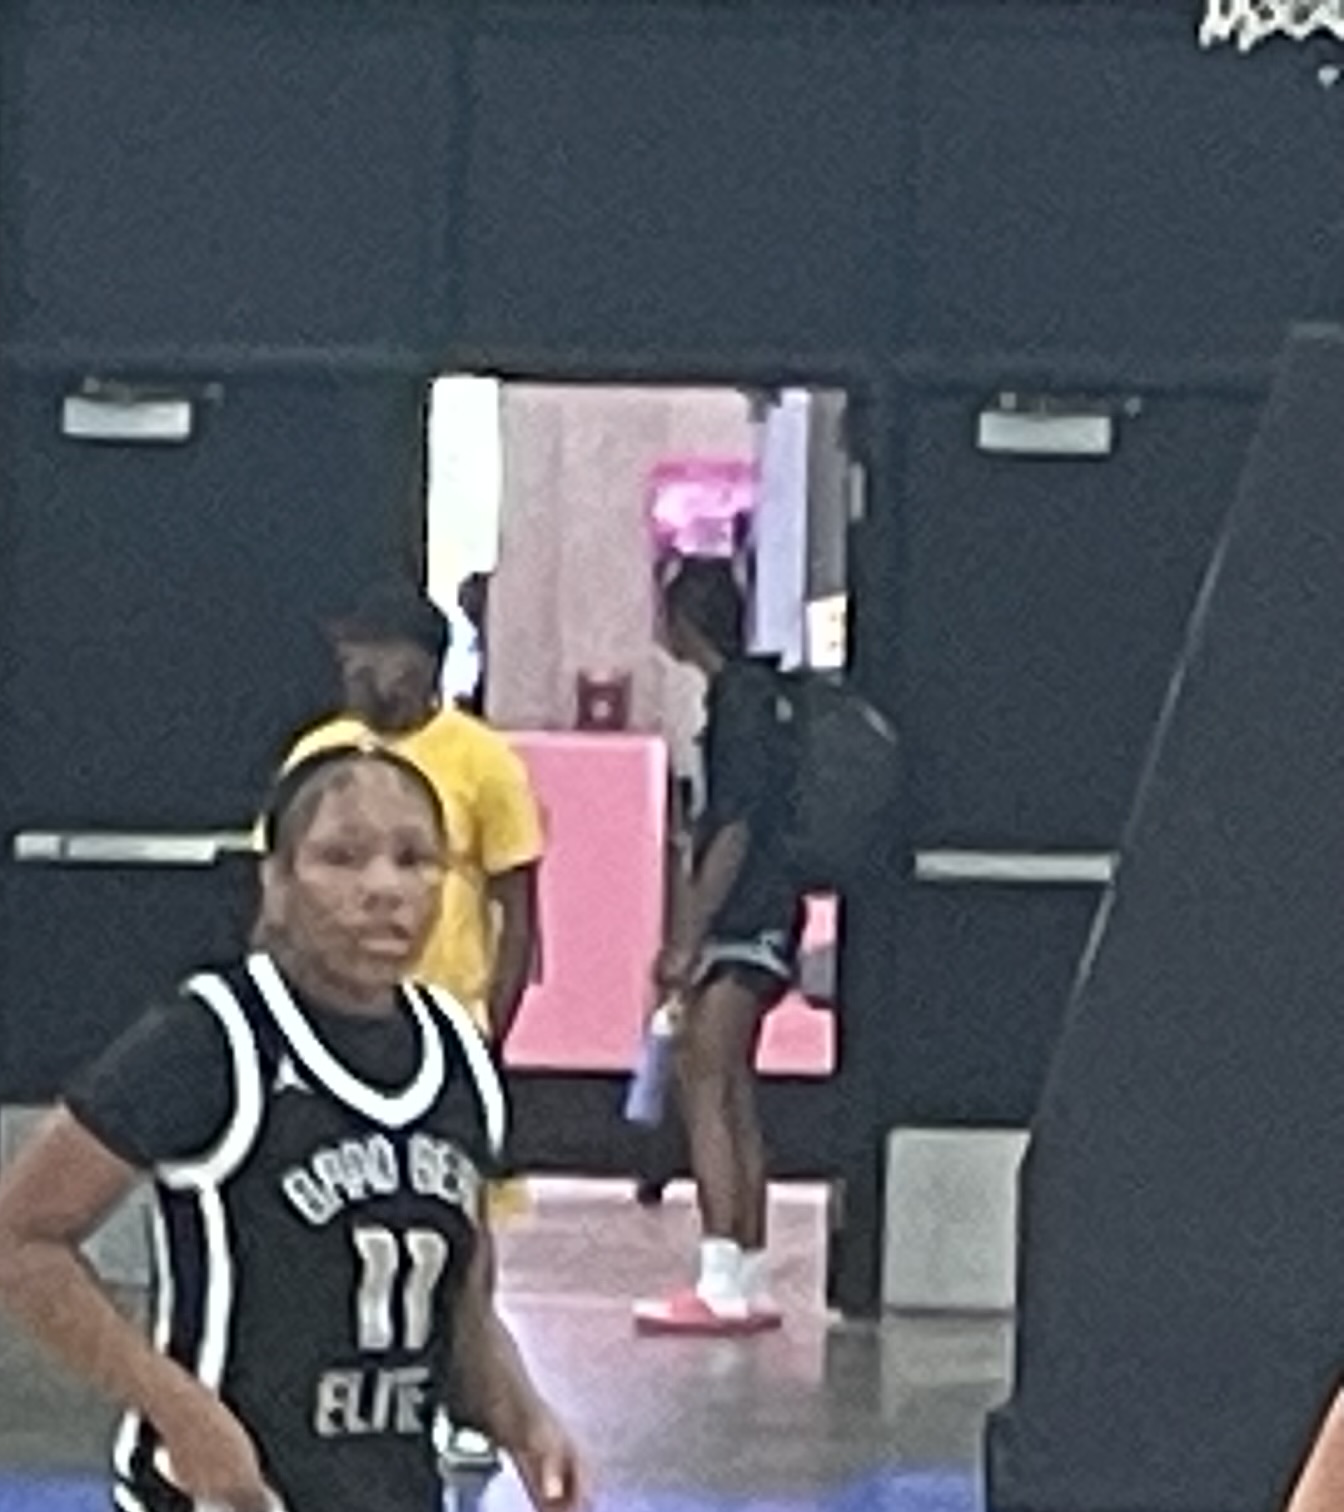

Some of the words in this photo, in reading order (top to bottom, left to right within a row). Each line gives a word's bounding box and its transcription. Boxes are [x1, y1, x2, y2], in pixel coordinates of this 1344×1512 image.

[282, 1132, 399, 1226] BRAD
[352, 1226, 449, 1352] 11
[315, 1366, 432, 1437] ELITE
